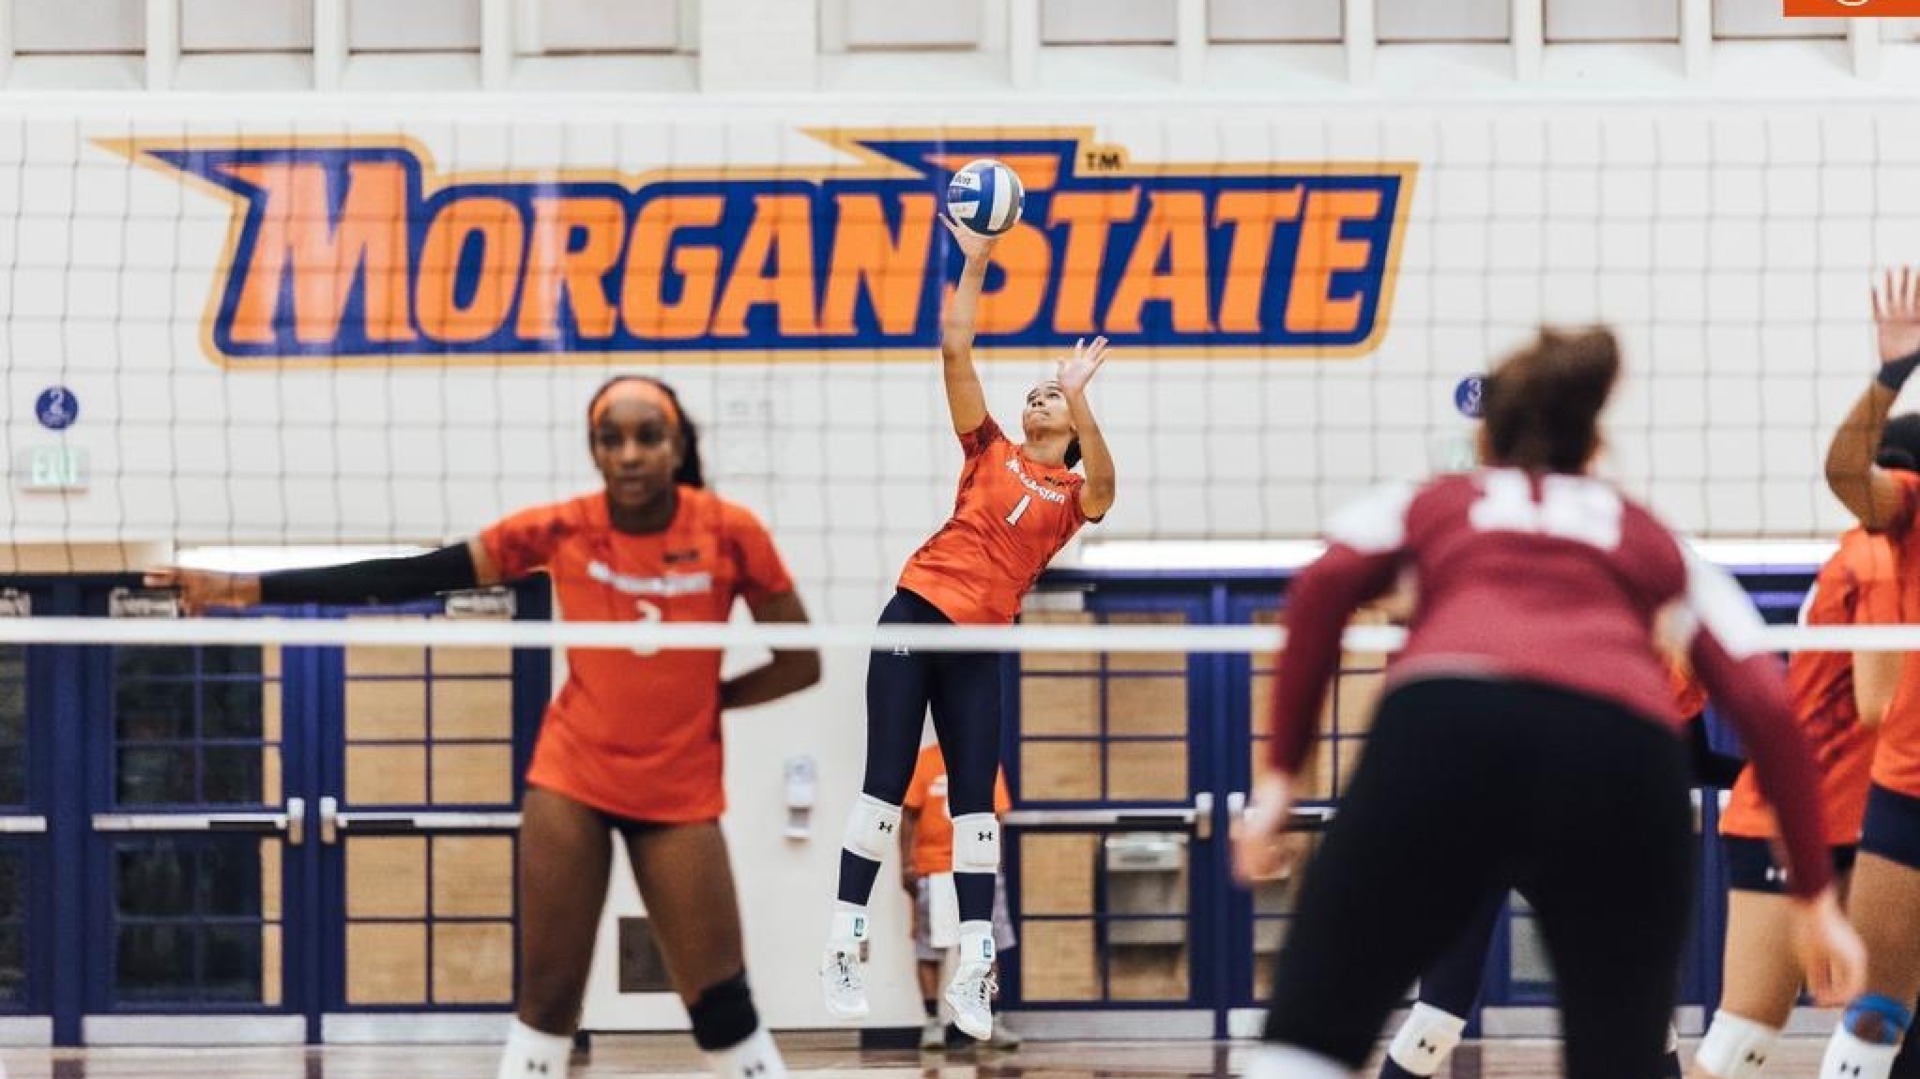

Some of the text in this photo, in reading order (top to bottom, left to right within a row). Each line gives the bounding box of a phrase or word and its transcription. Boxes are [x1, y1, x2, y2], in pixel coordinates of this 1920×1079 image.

[1086, 152, 1121, 171] TM
[211, 153, 1383, 342] MORGAN STATE
[49, 388, 64, 414] 2
[1005, 493, 1032, 527] 1
